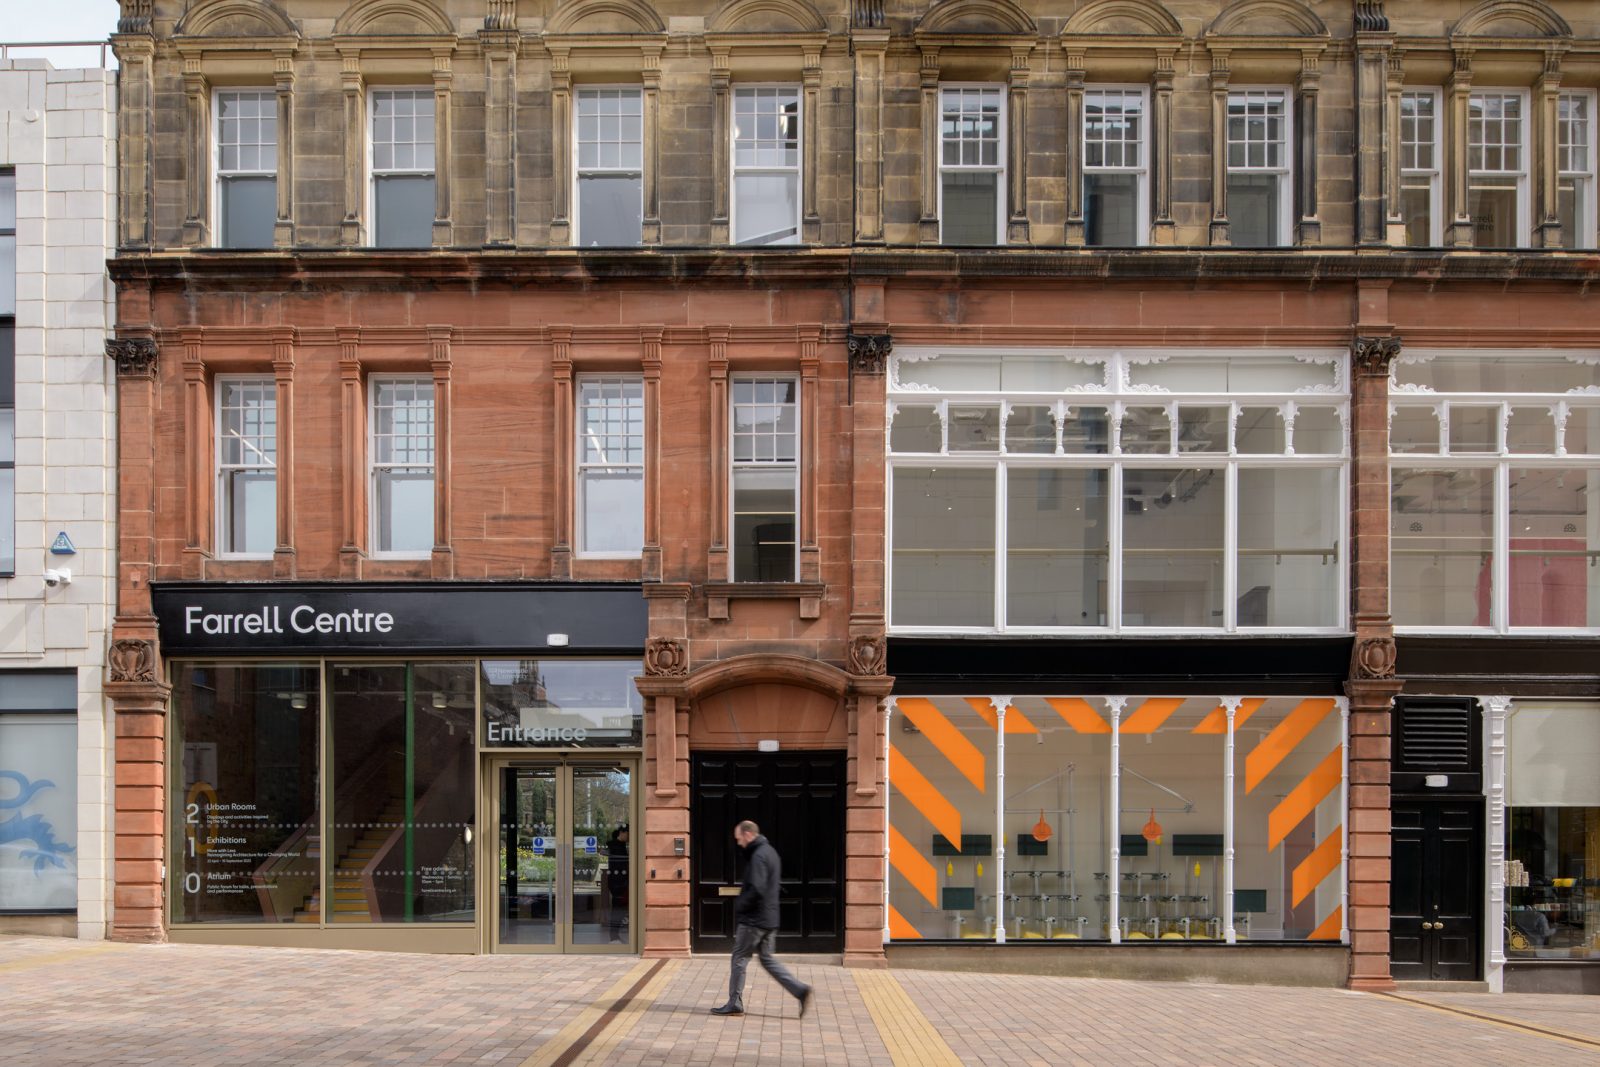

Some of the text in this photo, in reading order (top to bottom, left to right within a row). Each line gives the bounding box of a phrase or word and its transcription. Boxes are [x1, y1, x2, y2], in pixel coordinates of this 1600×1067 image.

[185, 604, 395, 635] Farrell Centre
[487, 721, 588, 742] Entrance
[186, 802, 257, 824] 2 Urban Rooms
[188, 836, 247, 857] 1 Exhibitions
[185, 872, 232, 893] 0 Atrium
